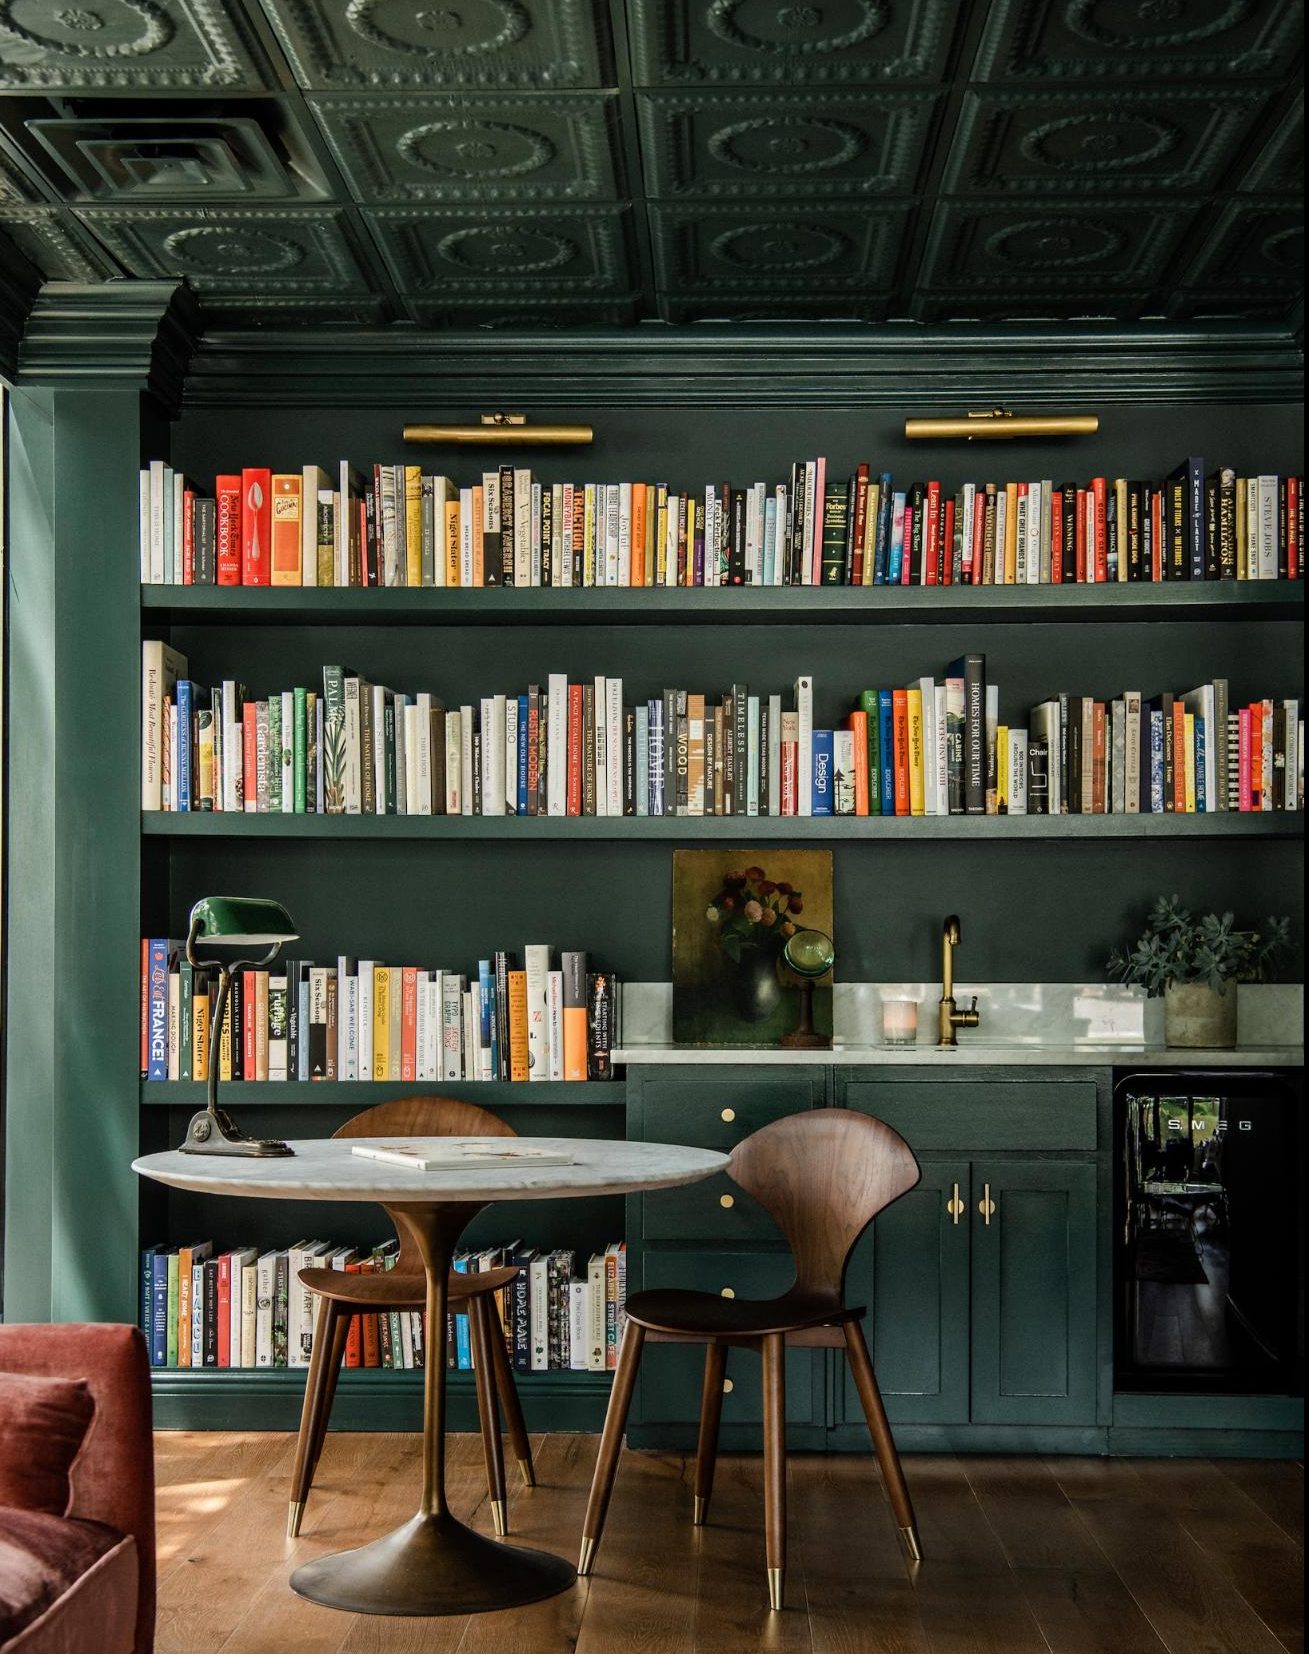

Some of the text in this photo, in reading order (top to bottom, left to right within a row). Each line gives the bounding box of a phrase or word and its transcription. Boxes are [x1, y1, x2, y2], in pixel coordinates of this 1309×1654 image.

[228, 495, 240, 512] New
[228, 513, 240, 532] York
[502, 476, 513, 566] GRAMERCY TAVERN
[564, 488, 572, 530] MONEYBALL
[573, 490, 584, 550] TRACTION
[930, 490, 939, 518] Lean In
[220, 494, 229, 556] COOKBOOK
[520, 520, 529, 564] Vegetables
[564, 534, 572, 557] MICHAEL
[986, 508, 994, 554] Wooden
[1098, 528, 1104, 538] TO
[1264, 496, 1272, 558] STEVE JOBS
[328, 680, 338, 725] PALMS
[146, 720, 156, 754] Beautiful
[508, 706, 516, 744] STUDIO
[912, 738, 920, 750] York
[971, 682, 980, 786] HOMES FOR OUR TIME
[257, 722, 268, 792] Gardenista
[528, 710, 537, 790] RUSTIC MODERN
[678, 734, 688, 775] WOOD
[1176, 712, 1184, 798] CITY FARMHOUSE STYLE
[587, 773, 593, 781] OF
[816, 754, 829, 794] Design
[1196, 762, 1204, 784] LIVABLE
[1196, 784, 1204, 800] HOME
[152, 1000, 164, 1061] FRANCE!
[196, 1008, 204, 1032] Nigel
[271, 993, 284, 1036] ruffage
[608, 1262, 616, 1302] ELIZABETH
[517, 1283, 528, 1350] HOME MADE
[608, 1304, 616, 1332] STREET
